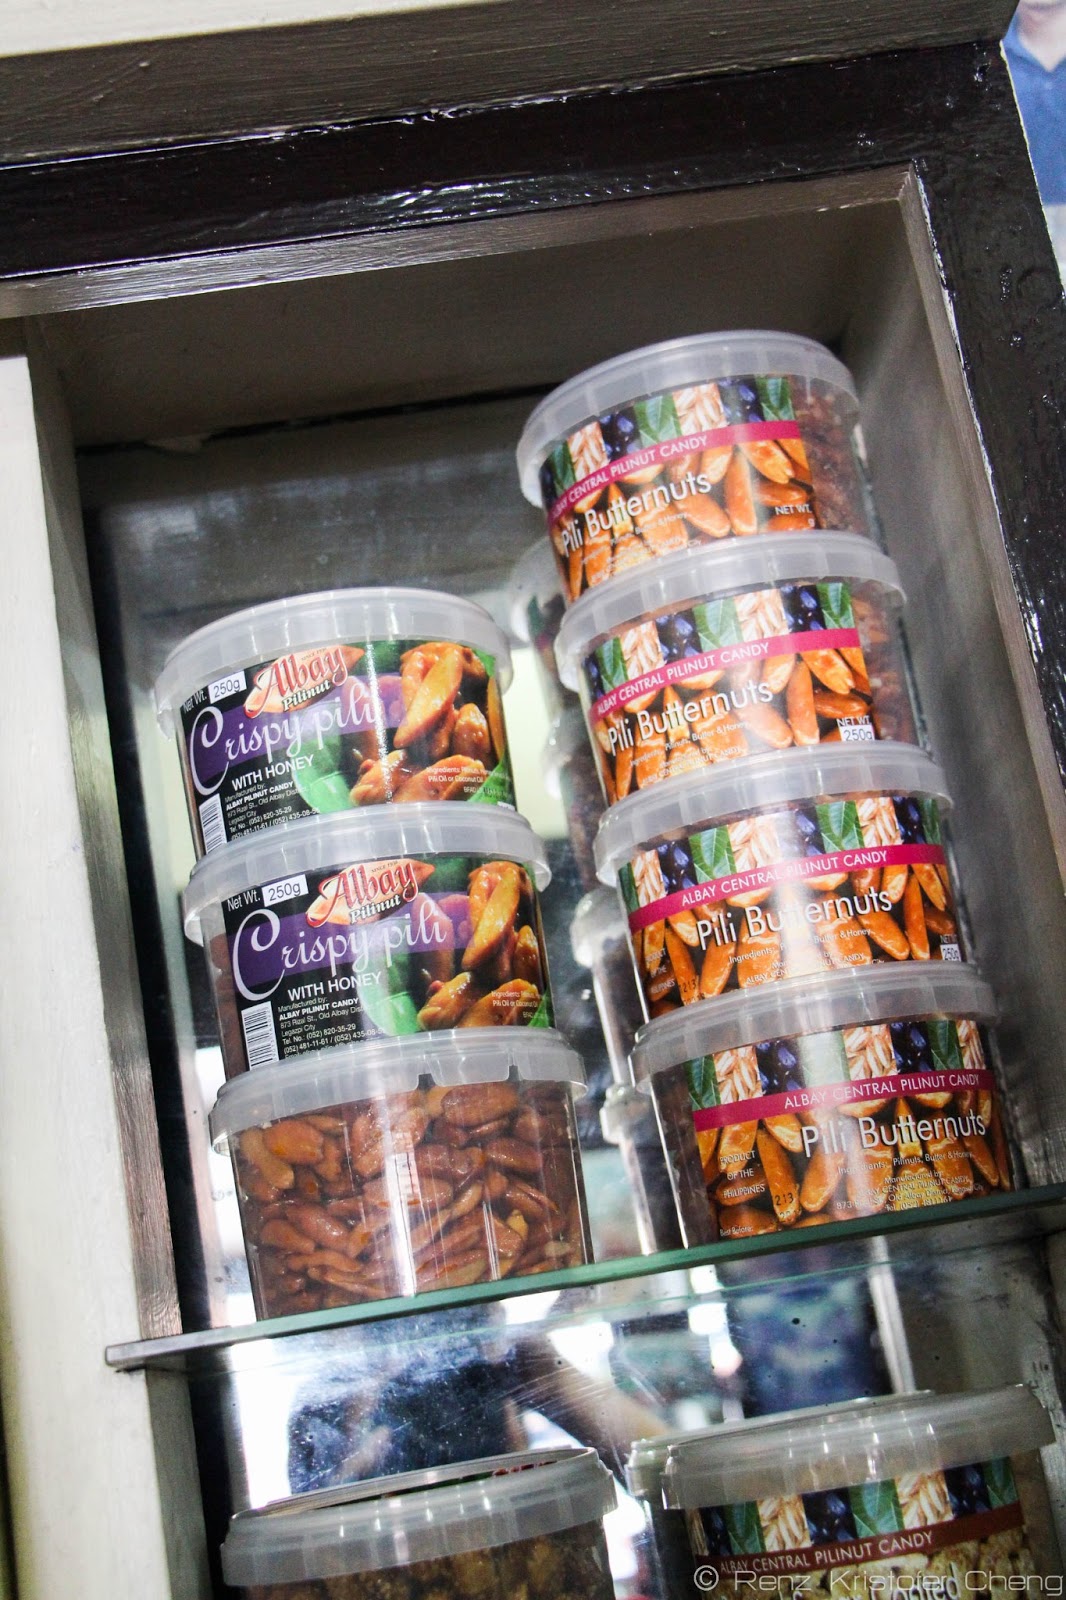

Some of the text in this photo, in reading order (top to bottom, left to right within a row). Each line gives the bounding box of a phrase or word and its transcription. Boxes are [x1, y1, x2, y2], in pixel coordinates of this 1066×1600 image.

[569, 434, 708, 503] CENTRAL PILINUT CANDY
[562, 518, 583, 557] Pili
[583, 471, 713, 538] Butternuts
[774, 504, 793, 516] NET
[243, 647, 349, 719] Albay
[618, 673, 664, 702] CENTRAL
[667, 654, 716, 680] PILINUT
[720, 642, 770, 664] CANDY
[213, 679, 241, 699] 250g
[281, 680, 331, 712] Pilinut
[607, 679, 773, 757] Pili Butternuts
[837, 718, 854, 727] NET
[189, 681, 379, 796] Crispy pili
[843, 730, 873, 741] 250g
[232, 753, 314, 792] WITH HONEY
[226, 798, 243, 811] ALBAY
[244, 788, 268, 803] PILINUT
[269, 780, 294, 793] CANDY
[258, 796, 269, 805] Old
[304, 861, 419, 928] Albay
[681, 849, 888, 908] ALBAY CENTRAL PILINUT CANDY
[227, 881, 302, 912] Net Wt. 250g
[350, 893, 401, 925] Pilinut
[696, 911, 737, 952] Pili
[848, 927, 871, 939] Honey
[232, 899, 447, 1002] Crispy pili
[288, 970, 382, 1002] WITH HONEY
[277, 998, 317, 1012] Manufactured
[279, 997, 360, 1021] ALBAY PILINUT CANDY
[318, 1012, 330, 1020] Old
[331, 1008, 349, 1018] Albay
[283, 1045, 299, 1055] (052)
[299, 1038, 329, 1050] 481-11-61
[334, 1032, 352, 1042] (052)
[303, 1024, 316, 1032] City
[306, 1030, 323, 1040] (052)
[323, 1023, 357, 1036] 820-35-29
[784, 1073, 980, 1110] ALBAY CENTRAL PILINUT CANDY
[801, 1109, 986, 1158] Pili Butternuts
[740, 1168, 754, 1178] THE
[893, 1156, 924, 1166] Pilinuts,
[925, 1153, 946, 1162] Butter
[720, 1531, 934, 1574] ALBAY CENTRAL PILINUT CANDY
